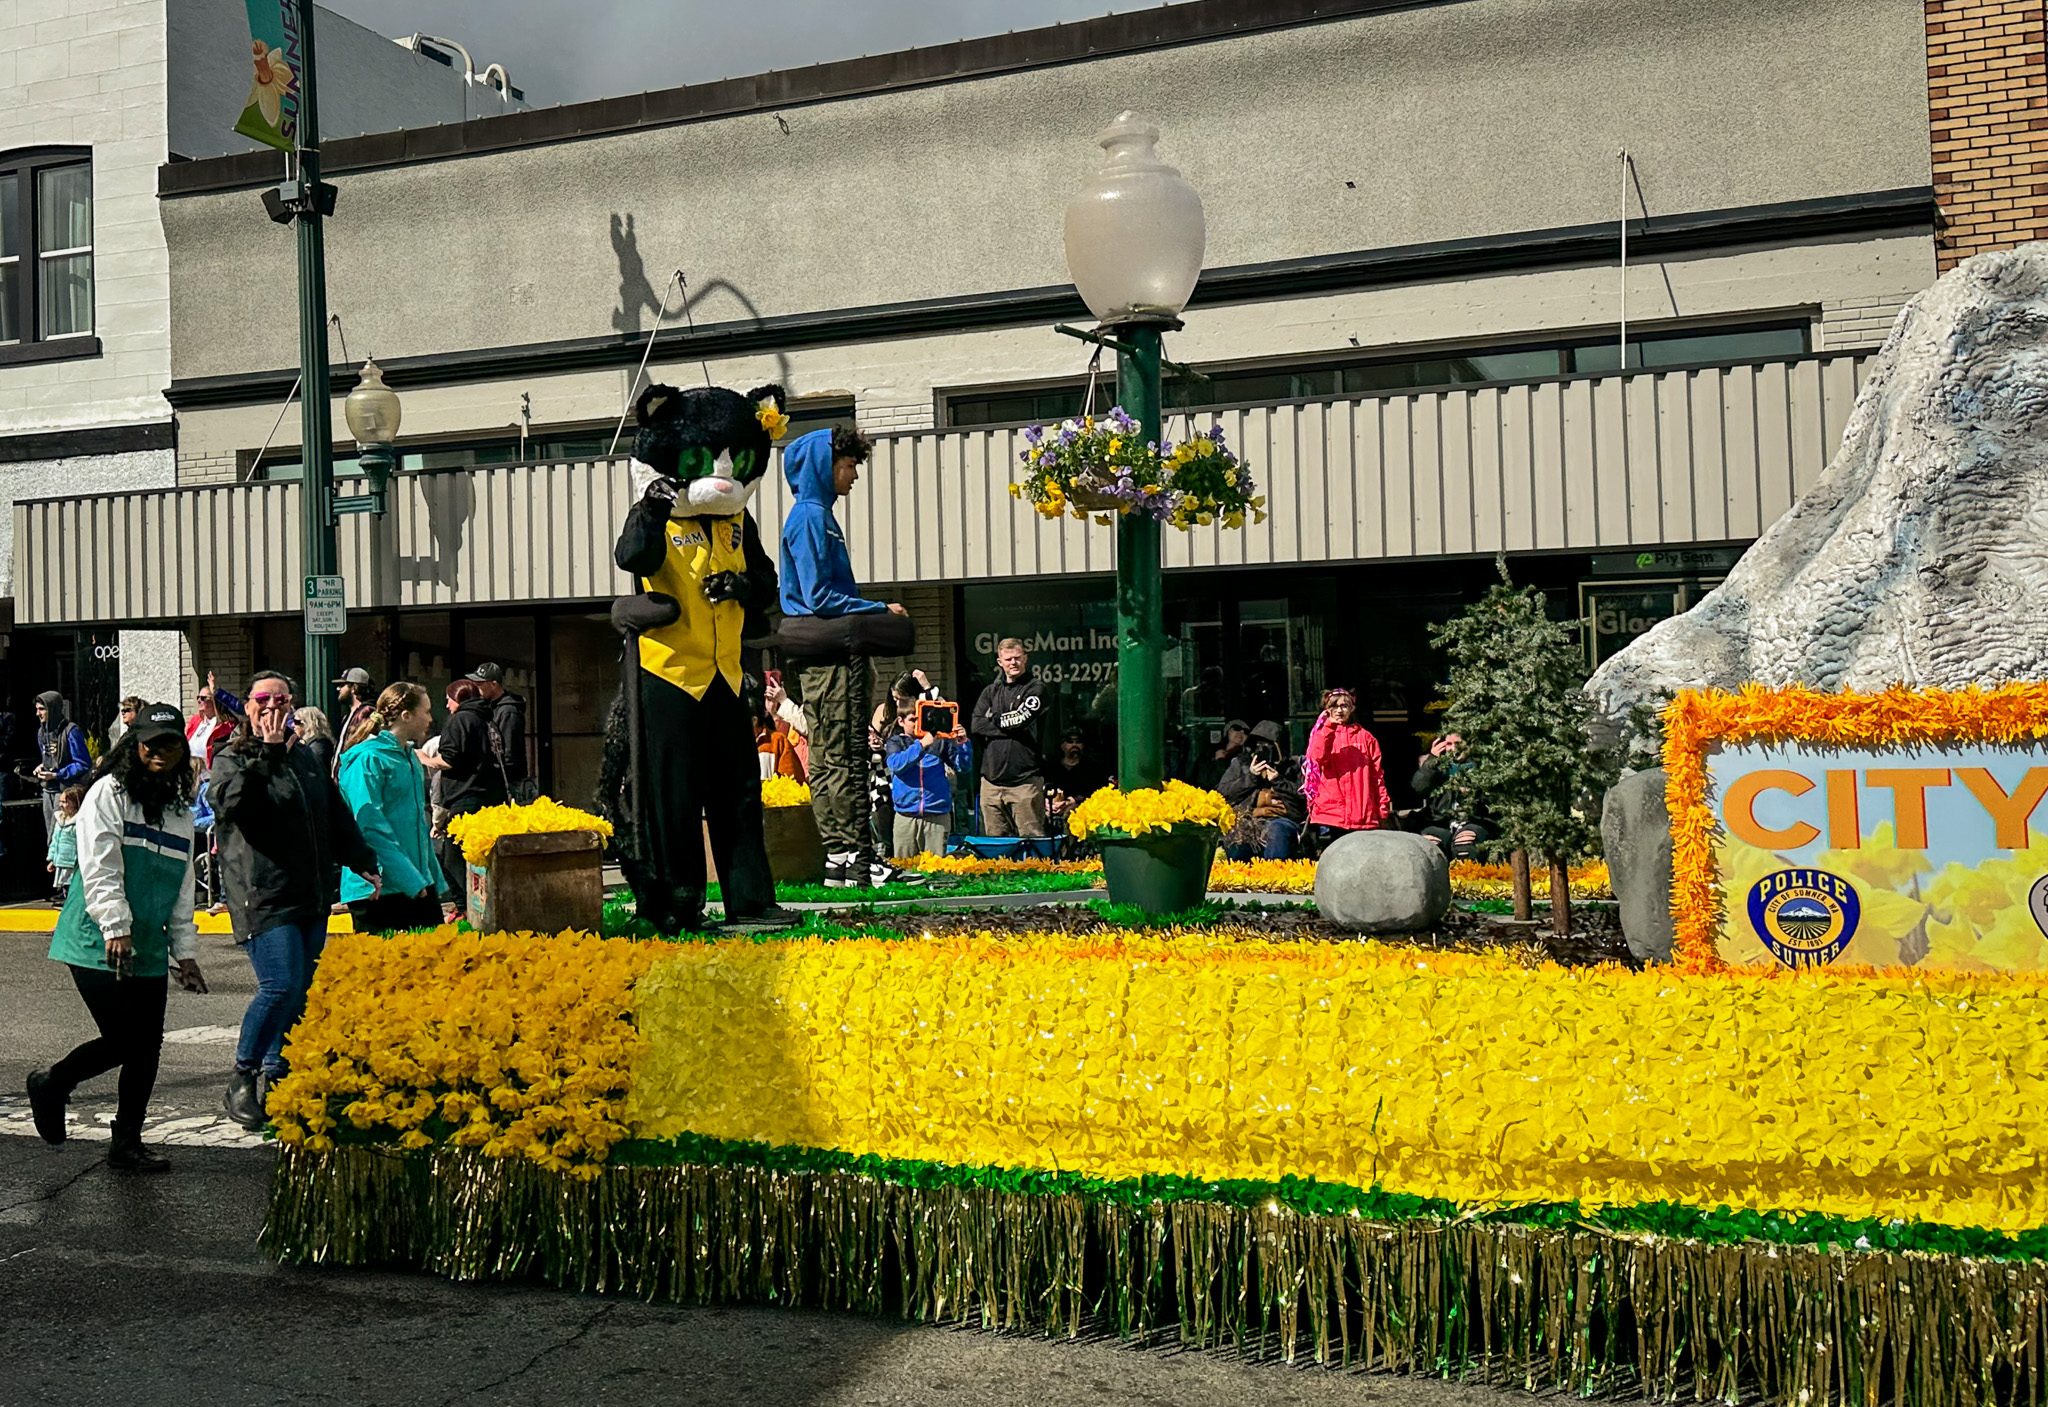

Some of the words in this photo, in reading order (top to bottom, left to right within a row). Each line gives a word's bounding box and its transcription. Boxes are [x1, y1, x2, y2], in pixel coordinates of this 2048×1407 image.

[672, 531, 705, 547] SAM
[1655, 552, 1678, 566] Ply
[1680, 551, 1714, 562] Gem
[307, 580, 315, 595] 3
[317, 588, 343, 596] PARKING
[309, 601, 342, 609] 9AM-6PM
[975, 630, 1084, 654] GlsMan
[94, 645, 119, 662] ope
[1721, 767, 2048, 850] CITY
[1760, 871, 1848, 904] POLICE
[1768, 899, 1781, 913] CITY
[1781, 892, 1791, 900] OF
[1828, 903, 1840, 914] WA
[1788, 938, 1802, 947] EST
[1806, 938, 1823, 947] 1891
[1772, 940, 1840, 968] SUMNER
